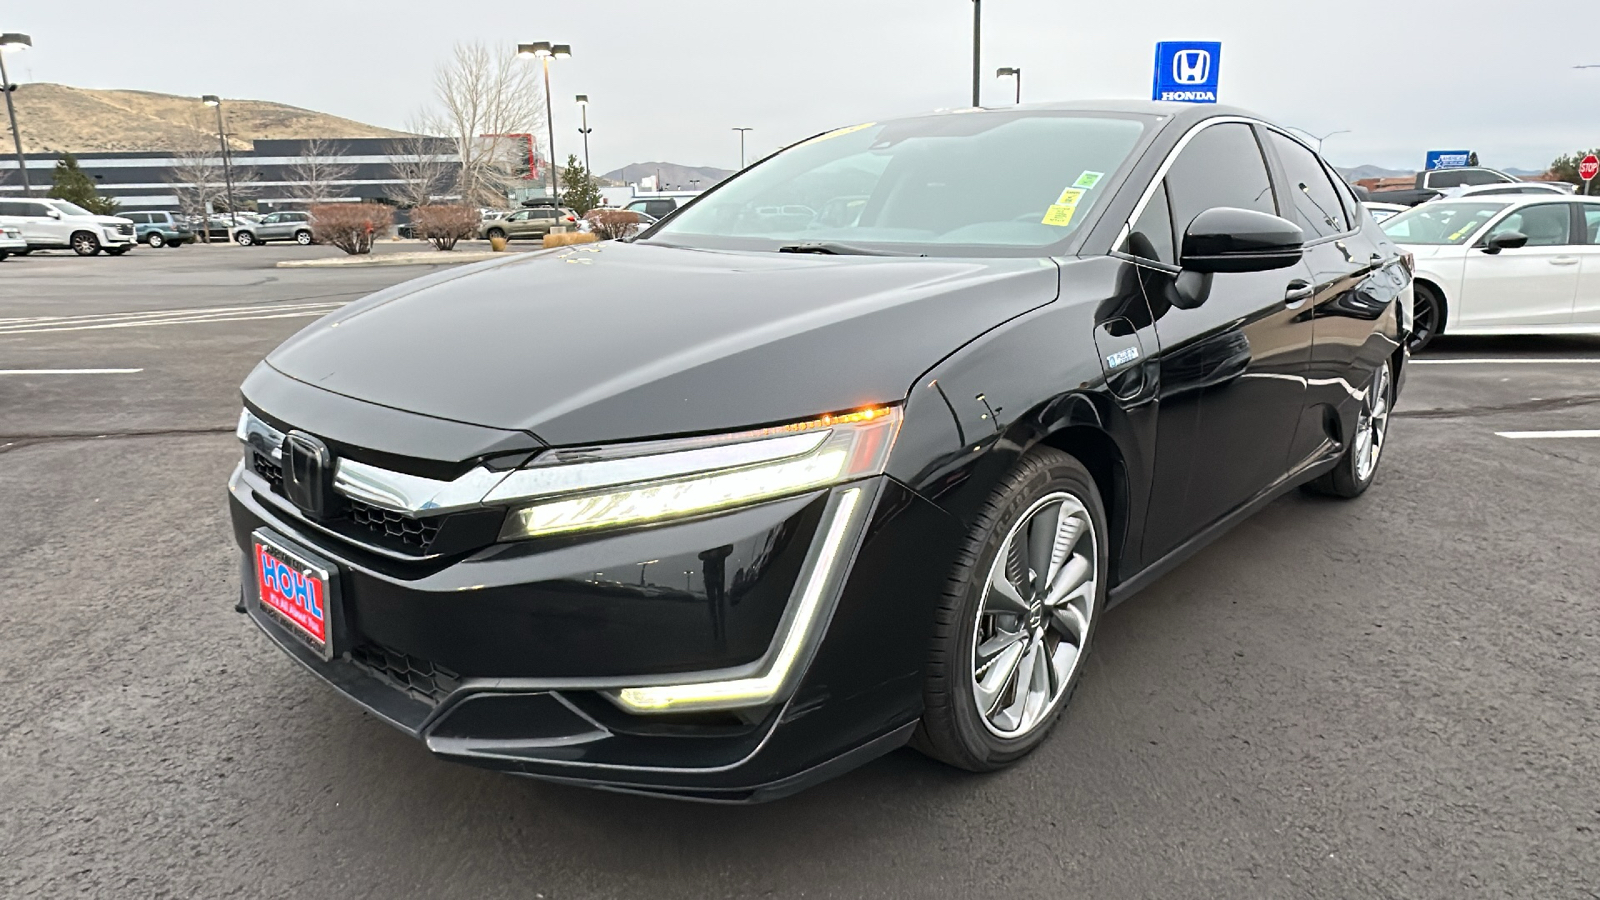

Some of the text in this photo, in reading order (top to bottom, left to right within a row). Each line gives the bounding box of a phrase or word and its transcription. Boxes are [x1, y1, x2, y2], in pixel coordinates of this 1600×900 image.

[1161, 91, 1216, 101] HONDA
[1581, 163, 1597, 173] STOP
[261, 553, 323, 619] HOHL
